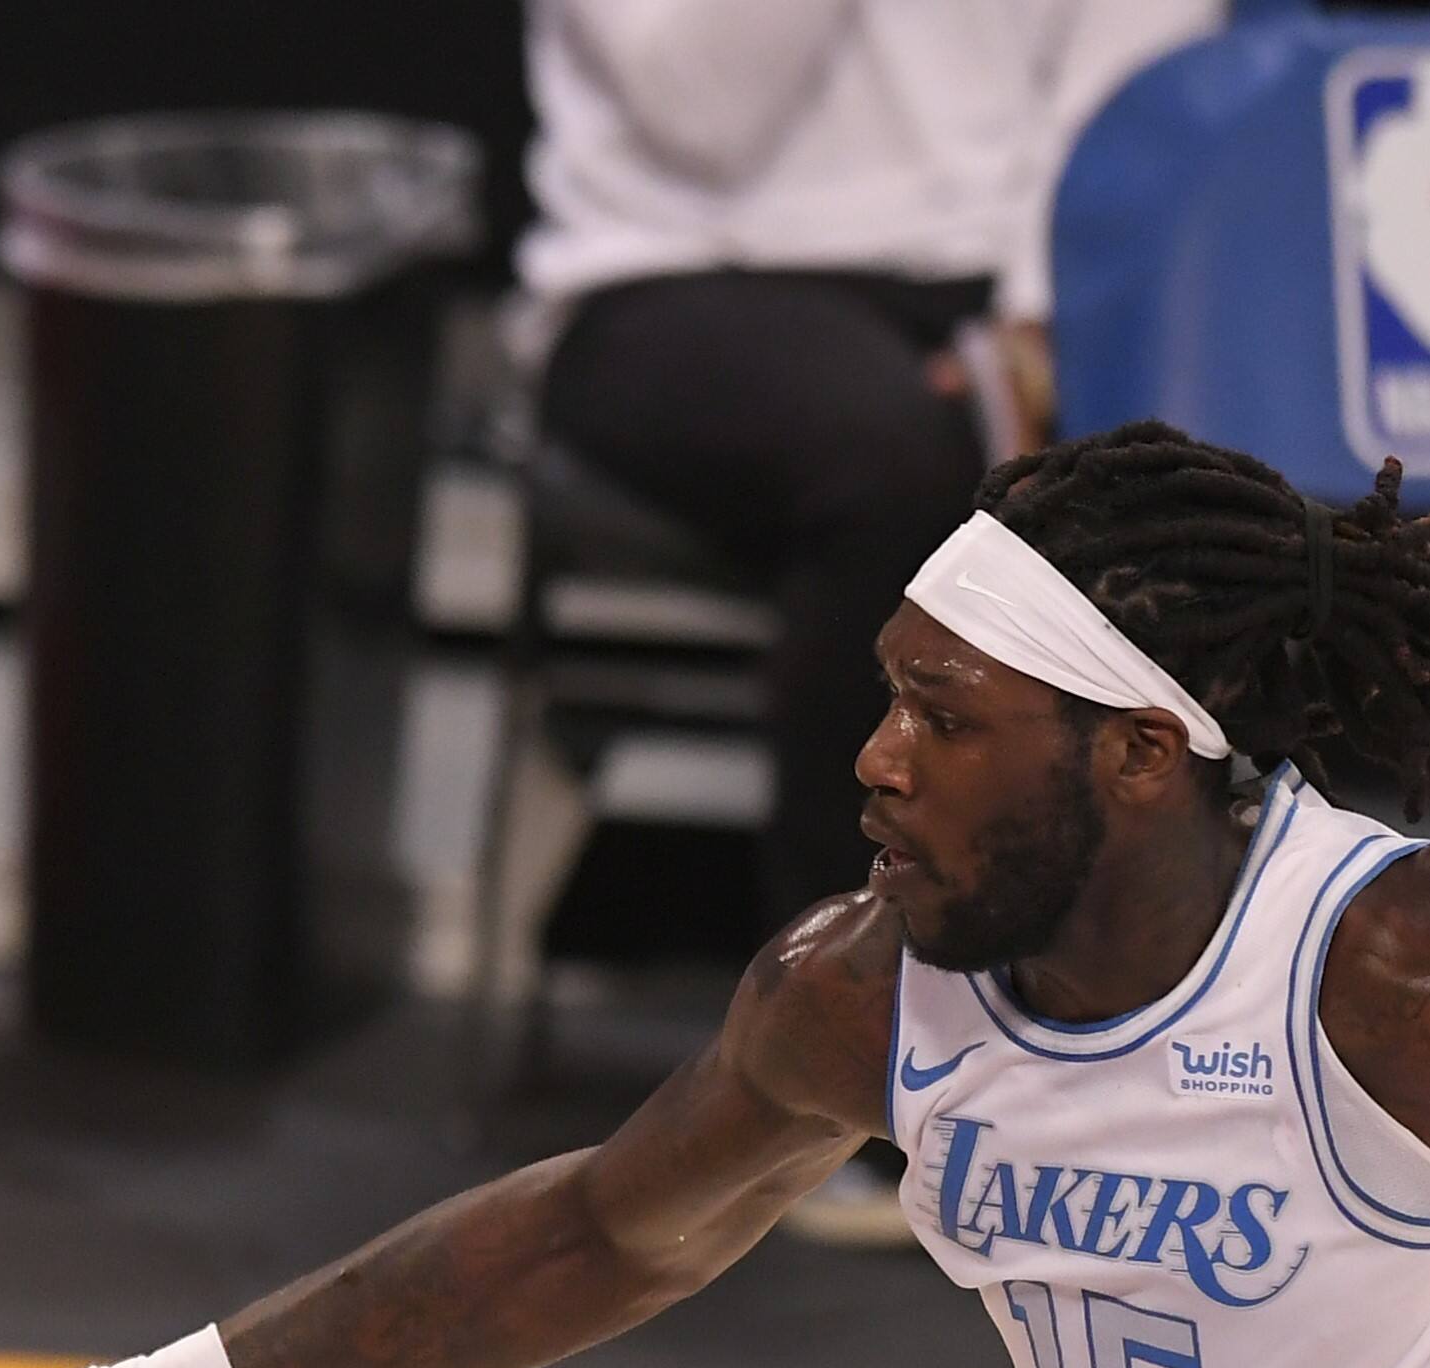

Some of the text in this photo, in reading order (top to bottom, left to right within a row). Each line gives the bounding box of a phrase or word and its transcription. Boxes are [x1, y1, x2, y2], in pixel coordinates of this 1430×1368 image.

[1171, 1041, 1273, 1080] wish
[1180, 1079, 1274, 1096] SHOPPING
[926, 1116, 1309, 1308] LAKERS
